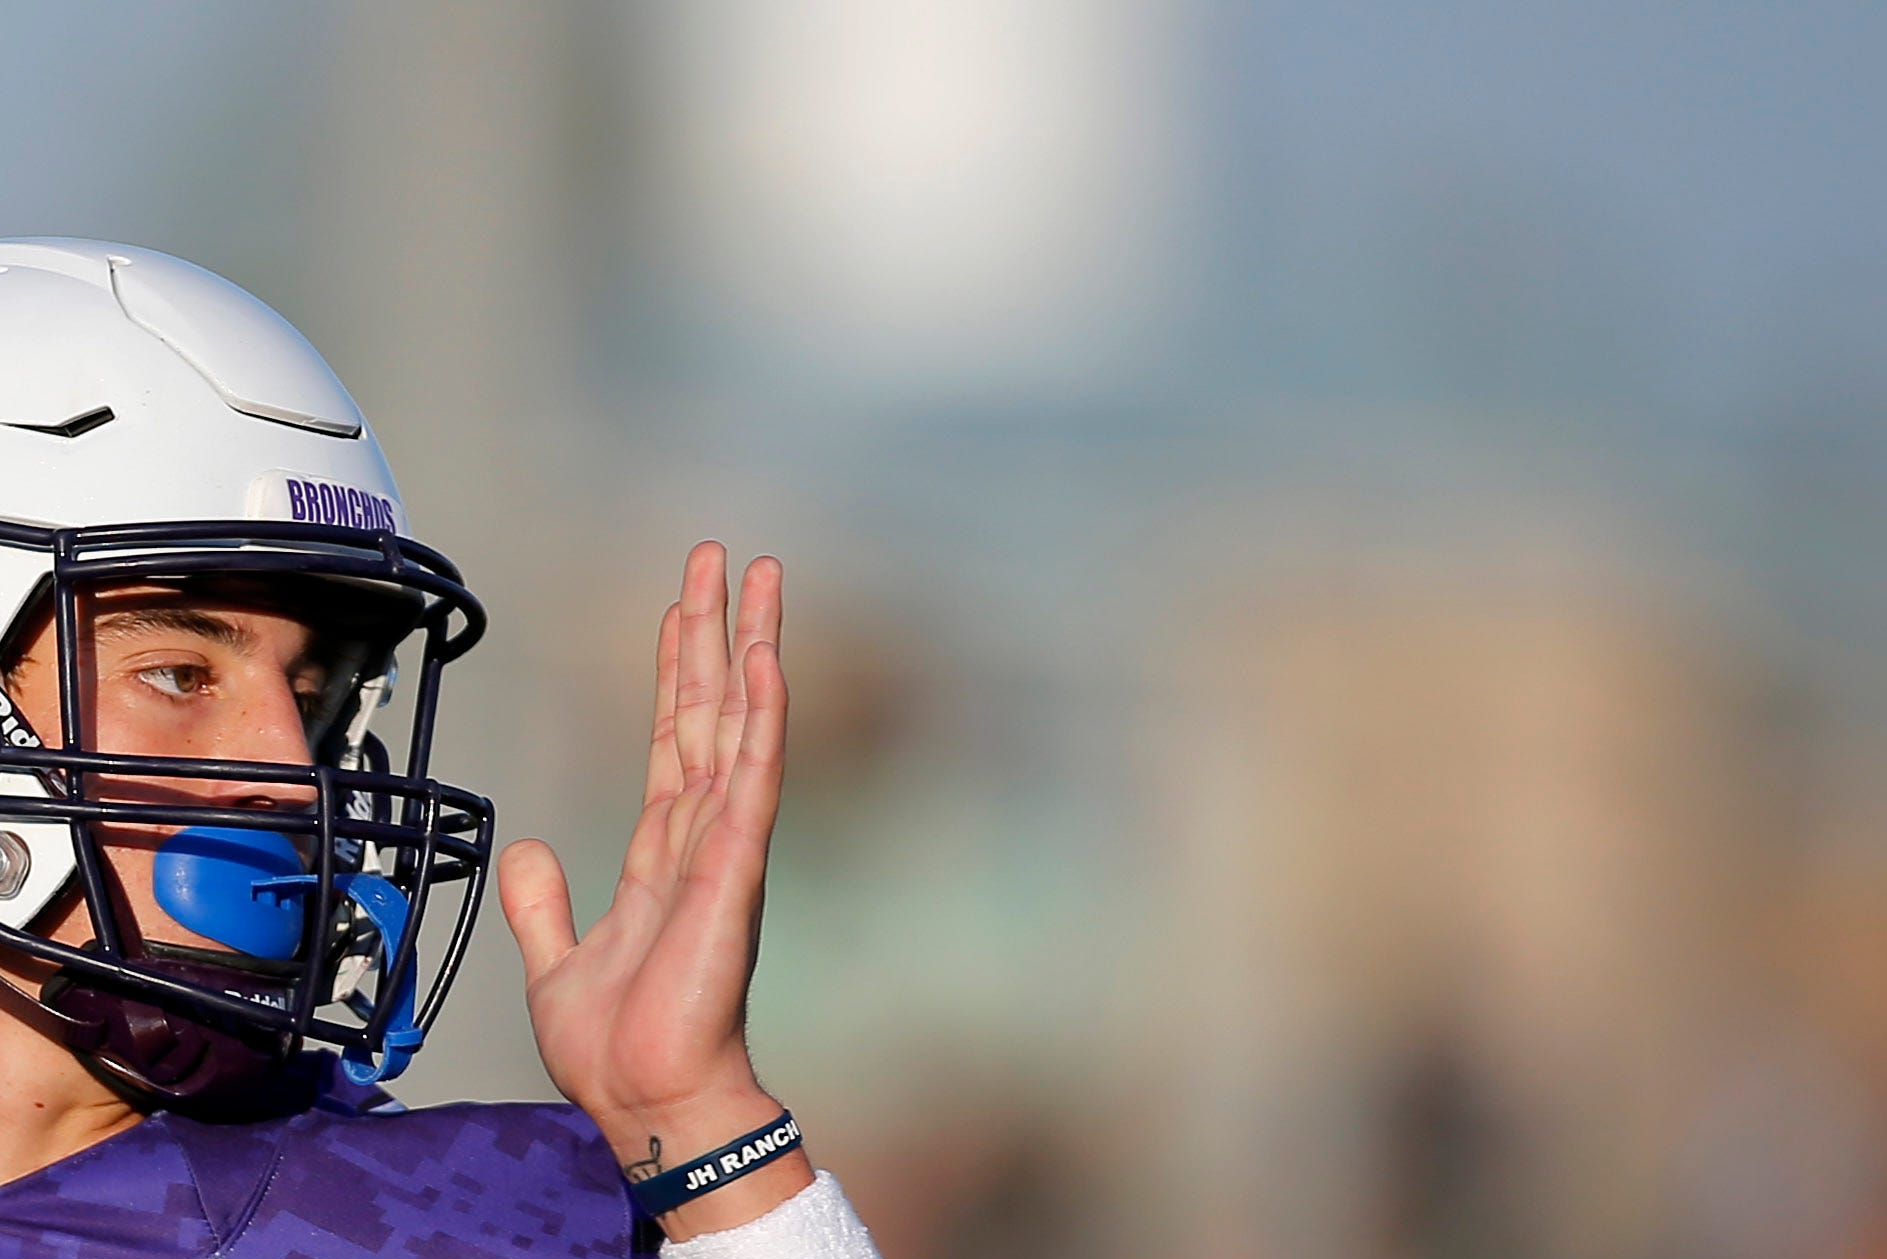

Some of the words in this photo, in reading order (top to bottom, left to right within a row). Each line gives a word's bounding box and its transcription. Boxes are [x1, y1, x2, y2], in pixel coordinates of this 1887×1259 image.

[286, 478, 395, 533] BRONCHOS
[685, 1164, 718, 1191] JH
[719, 1119, 800, 1174] RANCH
